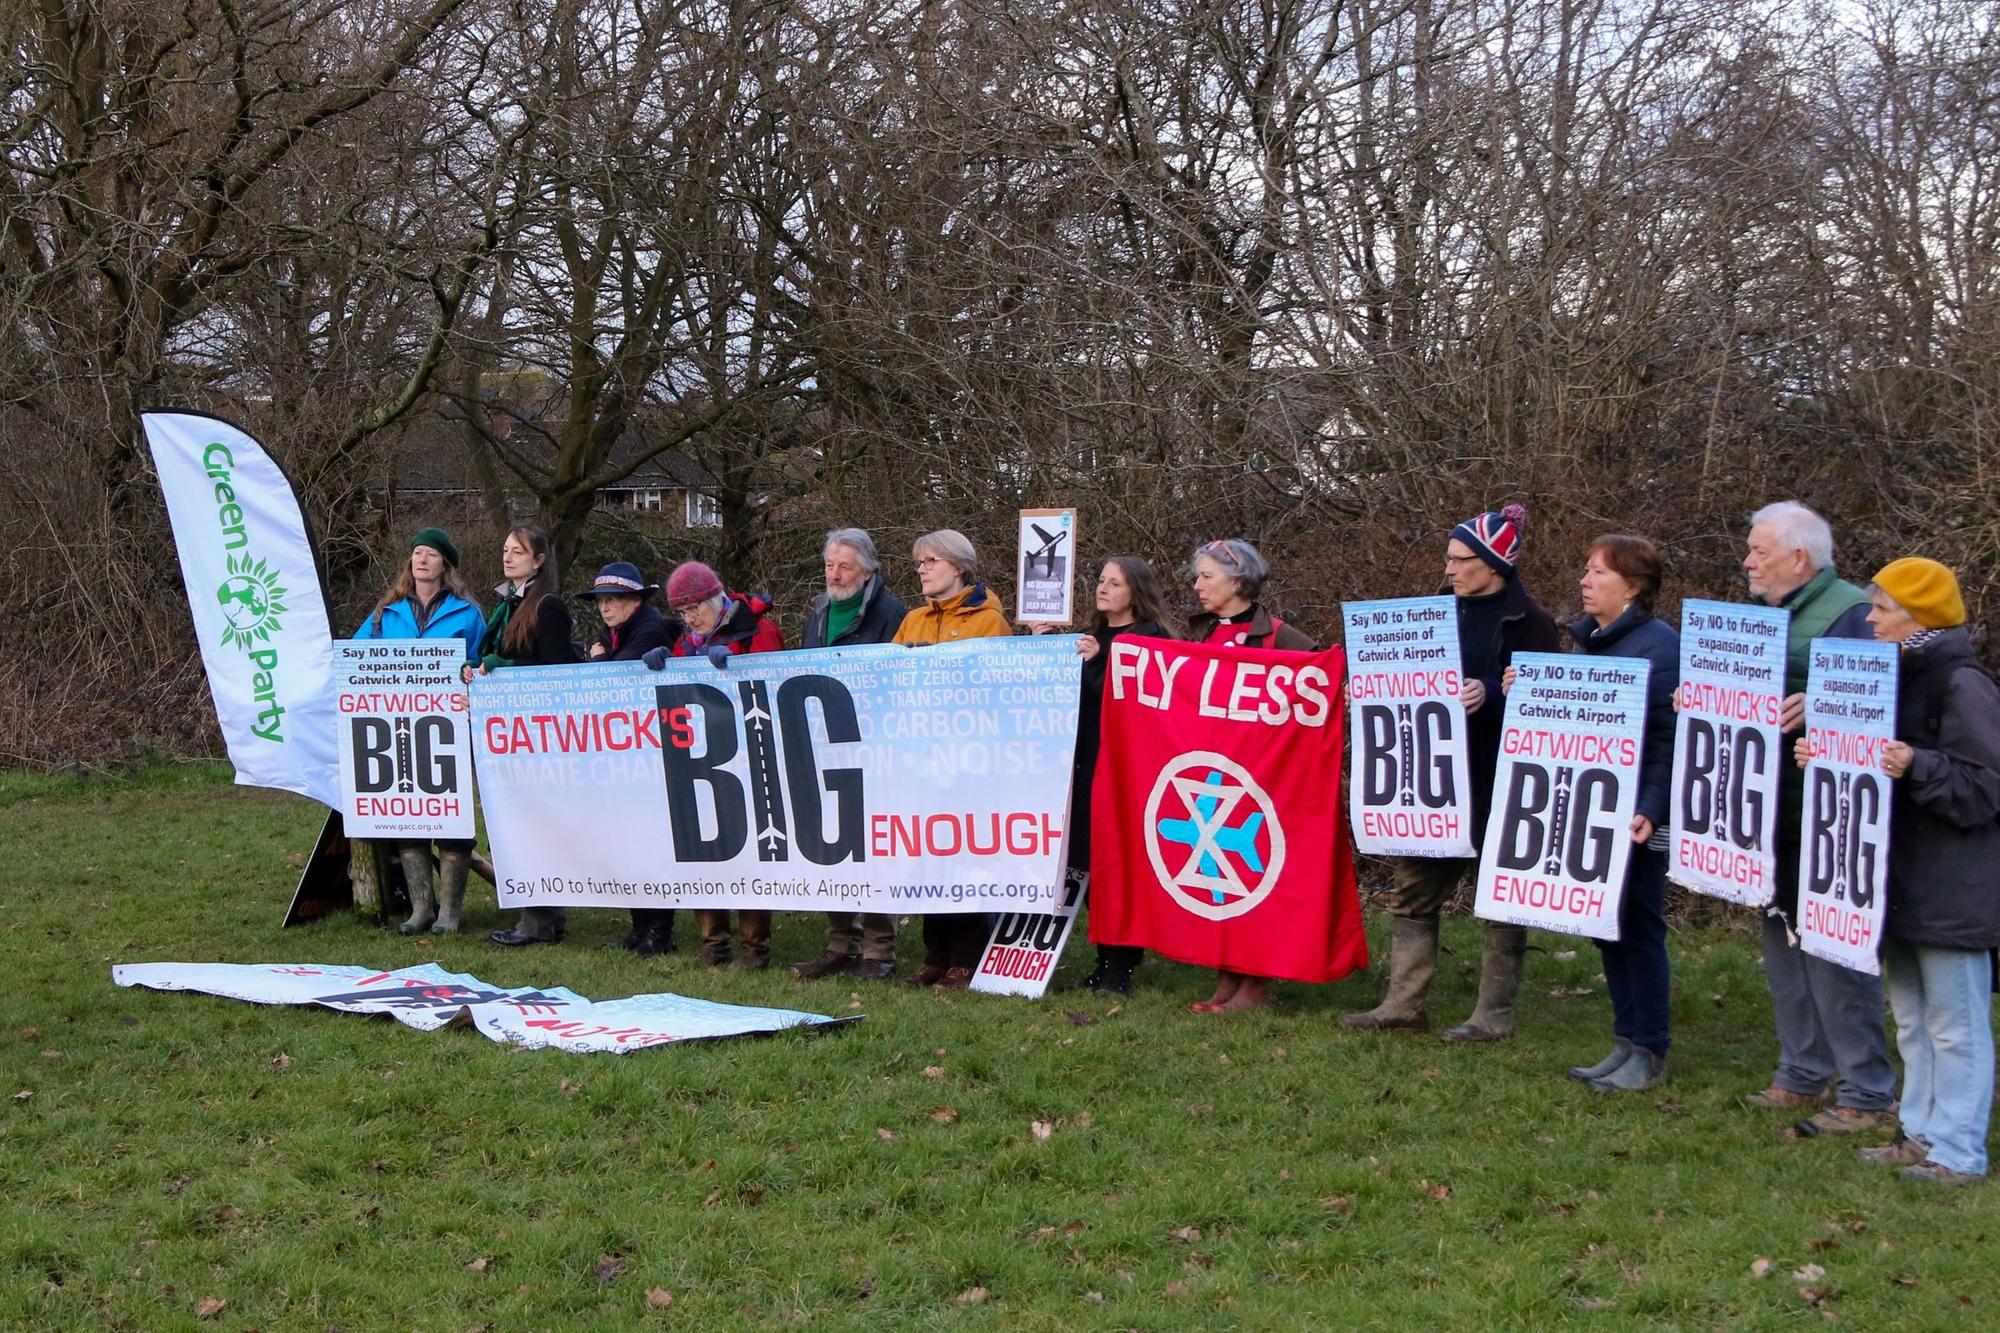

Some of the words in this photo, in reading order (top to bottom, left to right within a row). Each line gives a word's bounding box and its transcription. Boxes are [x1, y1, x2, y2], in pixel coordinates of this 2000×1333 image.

[203, 442, 249, 550] Green
[248, 648, 287, 744] Party
[1351, 614, 1369, 628] Say
[1373, 612, 1388, 624] NO
[1392, 612, 1403, 623] to
[1407, 608, 1447, 622] further
[1688, 612, 1704, 631] Say
[1707, 614, 1723, 629] NO
[1727, 617, 1737, 631] to
[1740, 618, 1778, 637] further
[1364, 629, 1418, 646] expansion
[1422, 626, 1434, 640] of
[1698, 637, 1749, 655] expansion
[1752, 642, 1766, 657] of
[342, 648, 365, 660] Say
[369, 648, 388, 657] NO
[393, 648, 406, 657] to
[410, 647, 455, 657] further
[358, 661, 423, 673] expansion
[428, 660, 440, 670] of
[1358, 647, 1399, 662] Gatwick
[1403, 646, 1446, 662] Airport
[1815, 652, 1830, 671] Say
[1847, 656, 1856, 671] to
[1857, 655, 1889, 673] further
[348, 675, 400, 685] Gatwick
[405, 675, 452, 686] Airport
[1519, 664, 1540, 681] Say
[1544, 666, 1564, 680] NO
[1569, 668, 1582, 681] to
[1588, 668, 1636, 684] further
[1690, 654, 1729, 674] Gatwick
[1732, 661, 1772, 681] Airport
[1111, 642, 1190, 711] FLY
[1199, 658, 1329, 727] LESS
[1351, 670, 1459, 699] GATWICK'S
[1531, 687, 1598, 702] expansion
[1602, 690, 1617, 703] of
[1824, 678, 1866, 696] expansion
[1868, 680, 1879, 696] of
[339, 693, 465, 713] GATWICK'S
[1519, 703, 1571, 720] Gatwick
[1576, 708, 1626, 726] Airport
[1681, 680, 1778, 725] GATWICK'S
[1814, 698, 1848, 717] Gatwick
[1850, 702, 1885, 723] Airport
[486, 706, 696, 755] GATWICK'S
[352, 715, 458, 794] BIG
[1361, 701, 1457, 809] BIG
[1504, 728, 1636, 767] GATWICK'S
[655, 674, 865, 865] BIG
[1681, 716, 1766, 852] BIG
[356, 798, 459, 816] ENOUGH
[374, 823, 444, 832] www.gacc.org.uk
[871, 812, 1063, 858] ENOUGH
[1363, 813, 1459, 839] ENOUGH
[1496, 761, 1619, 884] BIG
[1808, 766, 1880, 909] BIG
[1679, 839, 1764, 888] ENOUGH
[506, 878, 535, 898] Say
[541, 877, 564, 894] NO
[568, 880, 584, 894] to
[587, 878, 637, 895] further
[643, 878, 724, 900] expansion
[730, 878, 746, 895] of
[752, 877, 811, 897] Gatwick
[816, 880, 871, 901] Airport
[889, 881, 1054, 903] www.gacc.org.u
[1492, 875, 1605, 918] ENOUGH
[1805, 900, 1872, 949] ENOUGH
[981, 946, 1054, 982] ENOUGH
